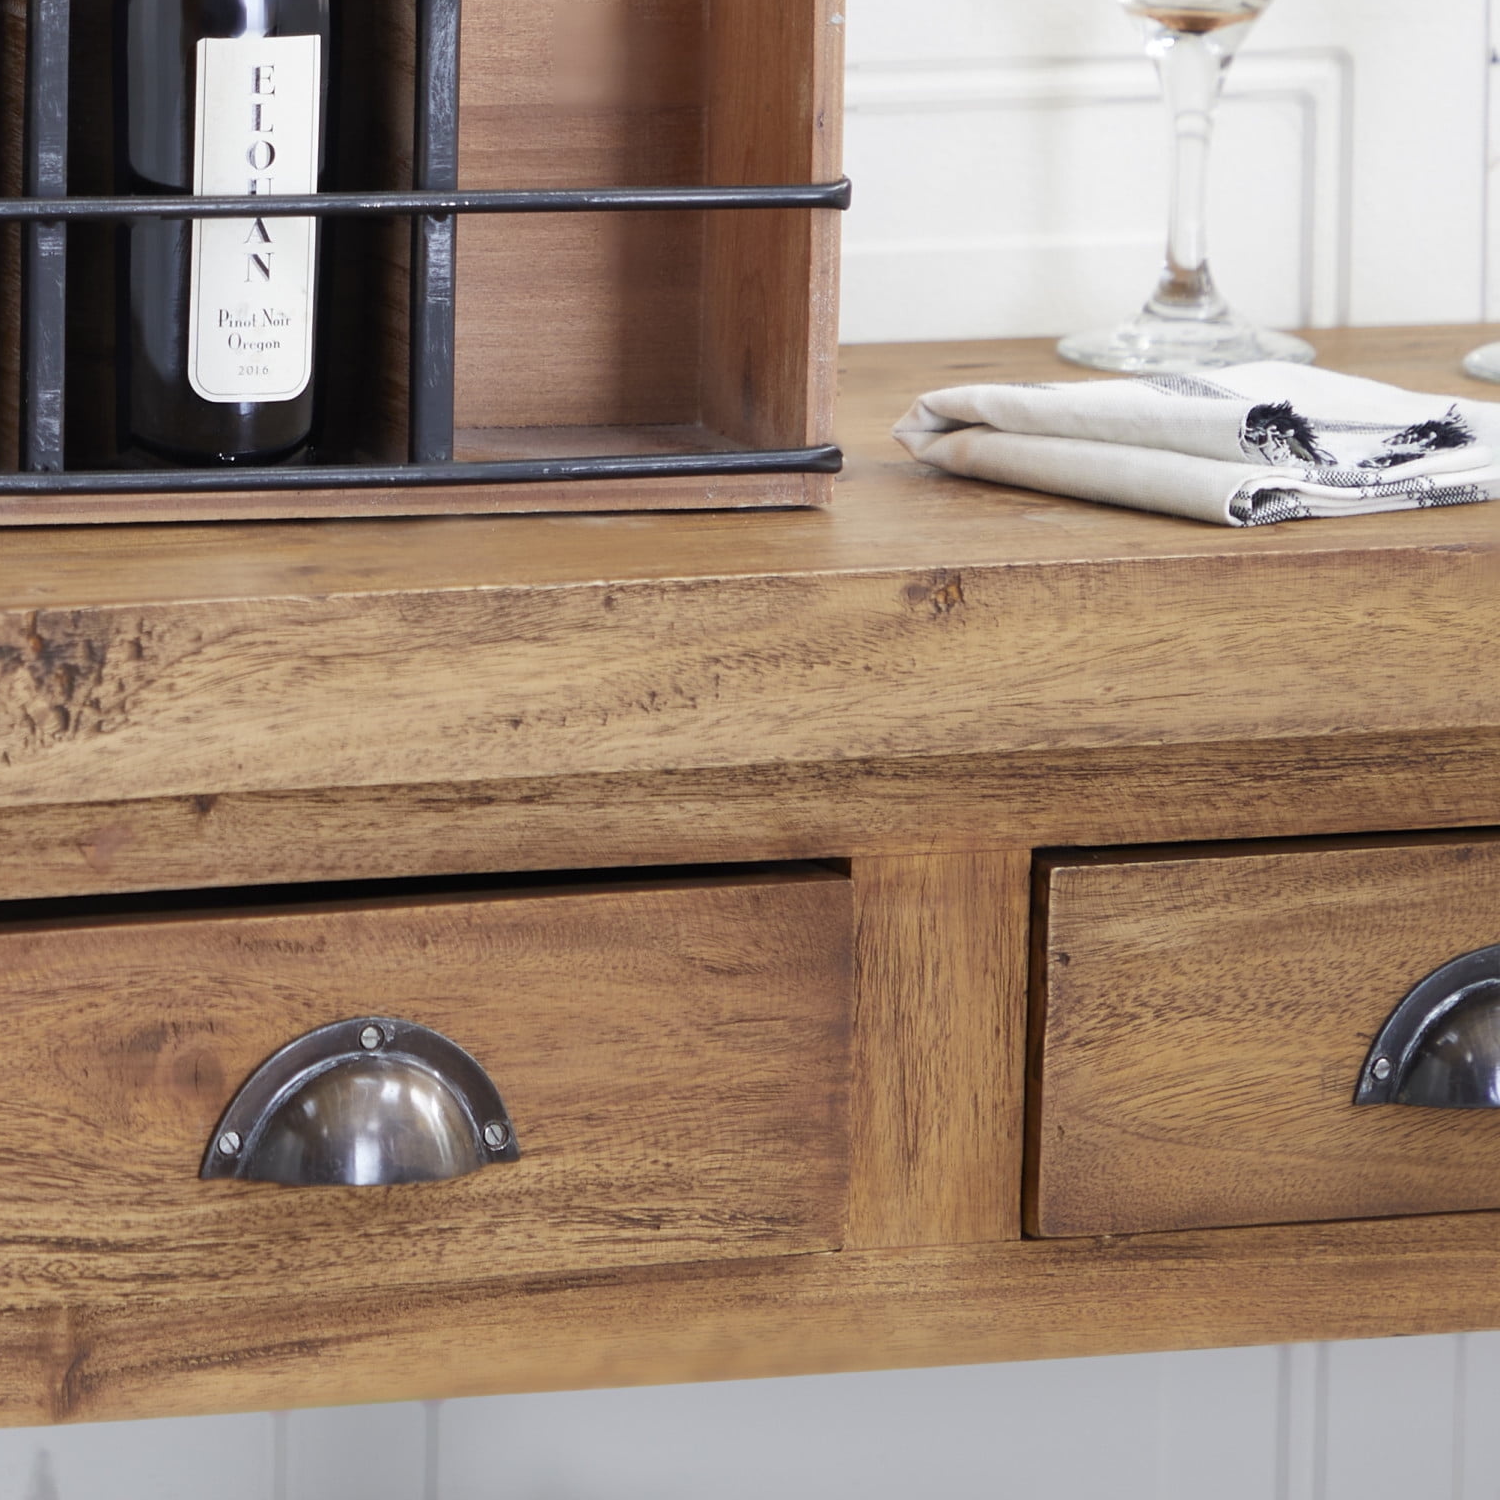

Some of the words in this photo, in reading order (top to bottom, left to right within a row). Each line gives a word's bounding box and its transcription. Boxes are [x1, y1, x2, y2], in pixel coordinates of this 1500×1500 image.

[219, 308, 255, 328] Pinot
[263, 308, 291, 328] Noir
[228, 332, 280, 353] Oregon
[238, 365, 269, 376] 2016
